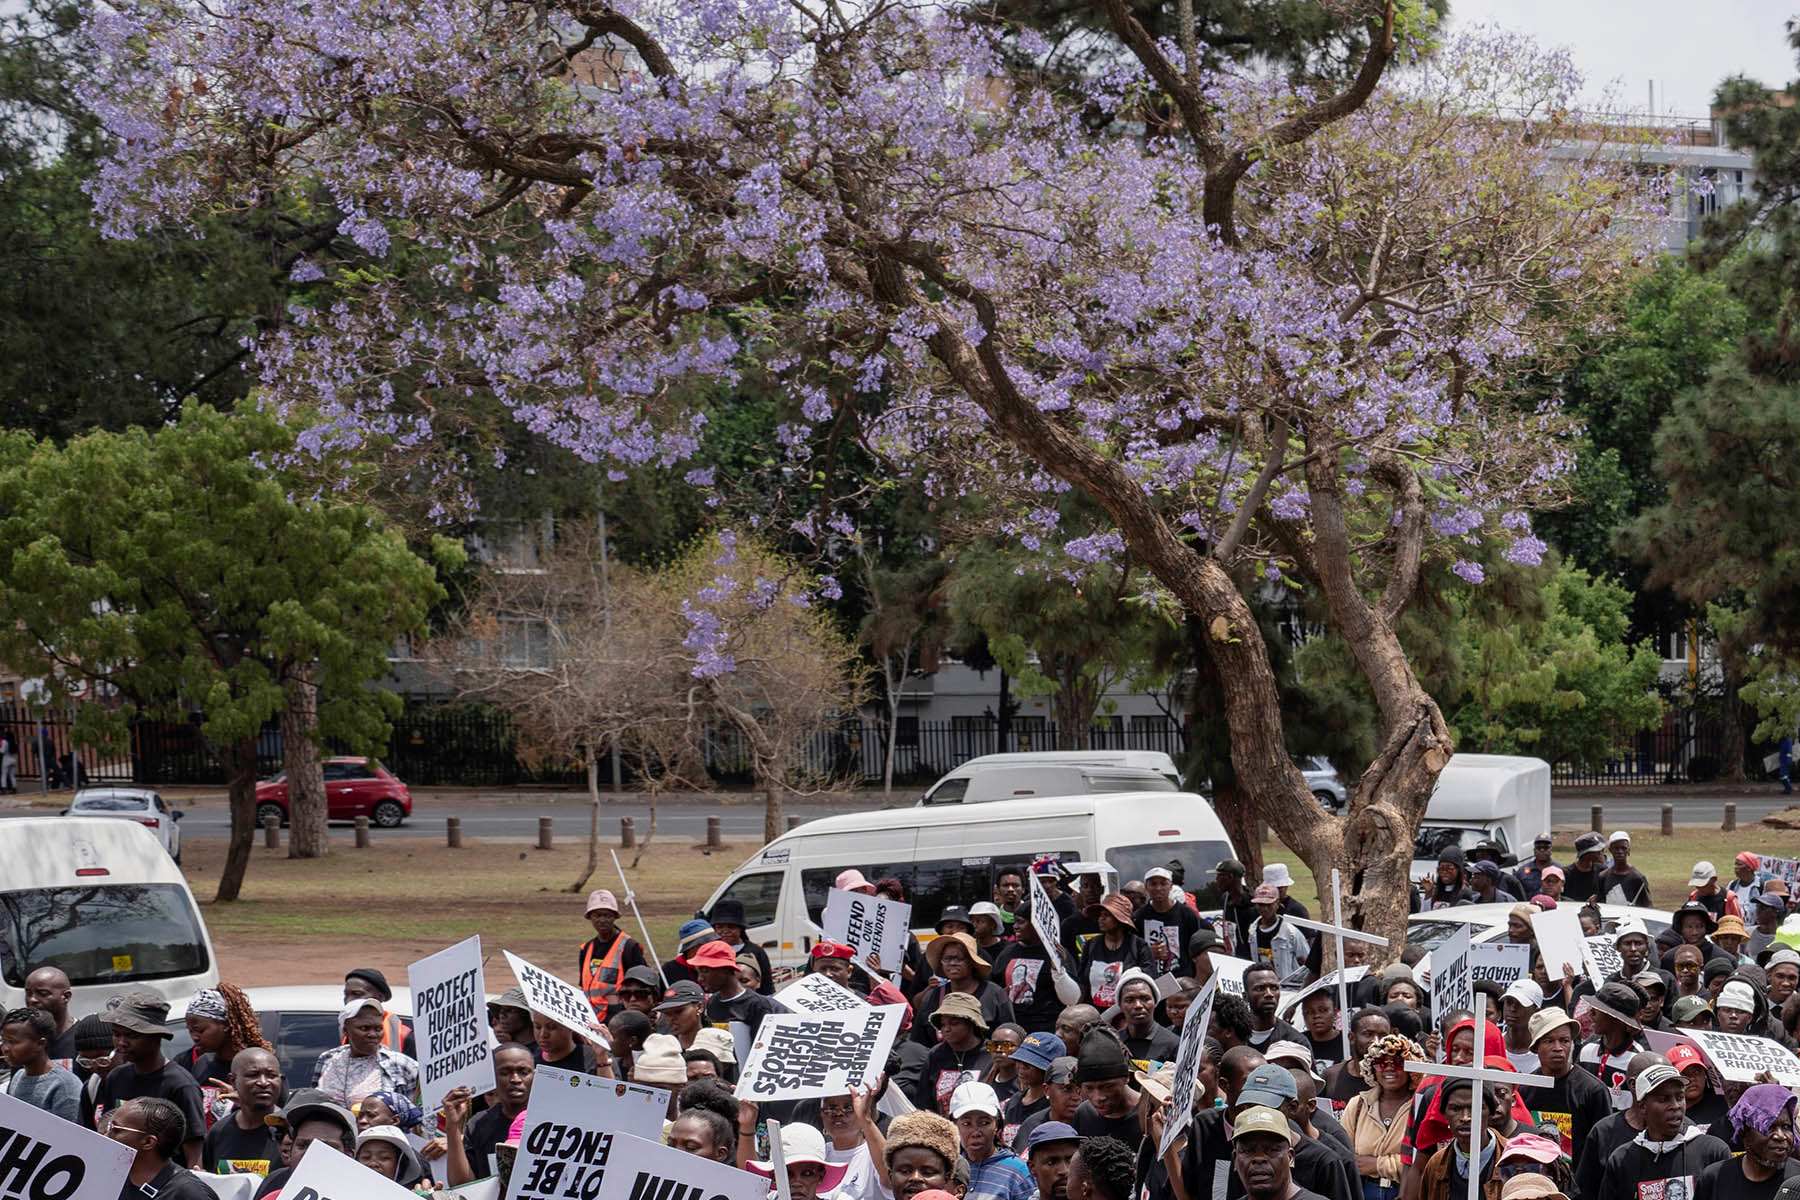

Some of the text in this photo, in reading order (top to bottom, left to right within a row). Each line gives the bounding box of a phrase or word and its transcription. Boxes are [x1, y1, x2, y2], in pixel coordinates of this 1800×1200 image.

[862, 919, 874, 943] OUR
[869, 903, 888, 959] DEFENDERS
[417, 968, 478, 1018] PROTECT
[521, 972, 590, 1014] KILLED
[524, 965, 574, 998] WHO
[1434, 951, 1468, 997] WE WILL
[1440, 972, 1468, 1012] NOT BE
[428, 995, 476, 1036] HUMAN
[430, 1018, 478, 1059] RIGHTS
[776, 1021, 822, 1090] RIGHTS
[801, 1020, 844, 1088] HUMAN
[829, 1030, 862, 1072] OUR
[845, 1011, 886, 1088] REMEMBER
[1703, 1033, 1765, 1047] WHO
[1703, 1039, 1787, 1058] KILLED
[425, 1040, 488, 1084] DEFENDERS
[752, 1024, 799, 1096] HEROES
[1716, 1051, 1797, 1068] BAZOOKA
[1725, 1060, 1800, 1076] RHADEBE?
[522, 1158, 568, 1196] BE
